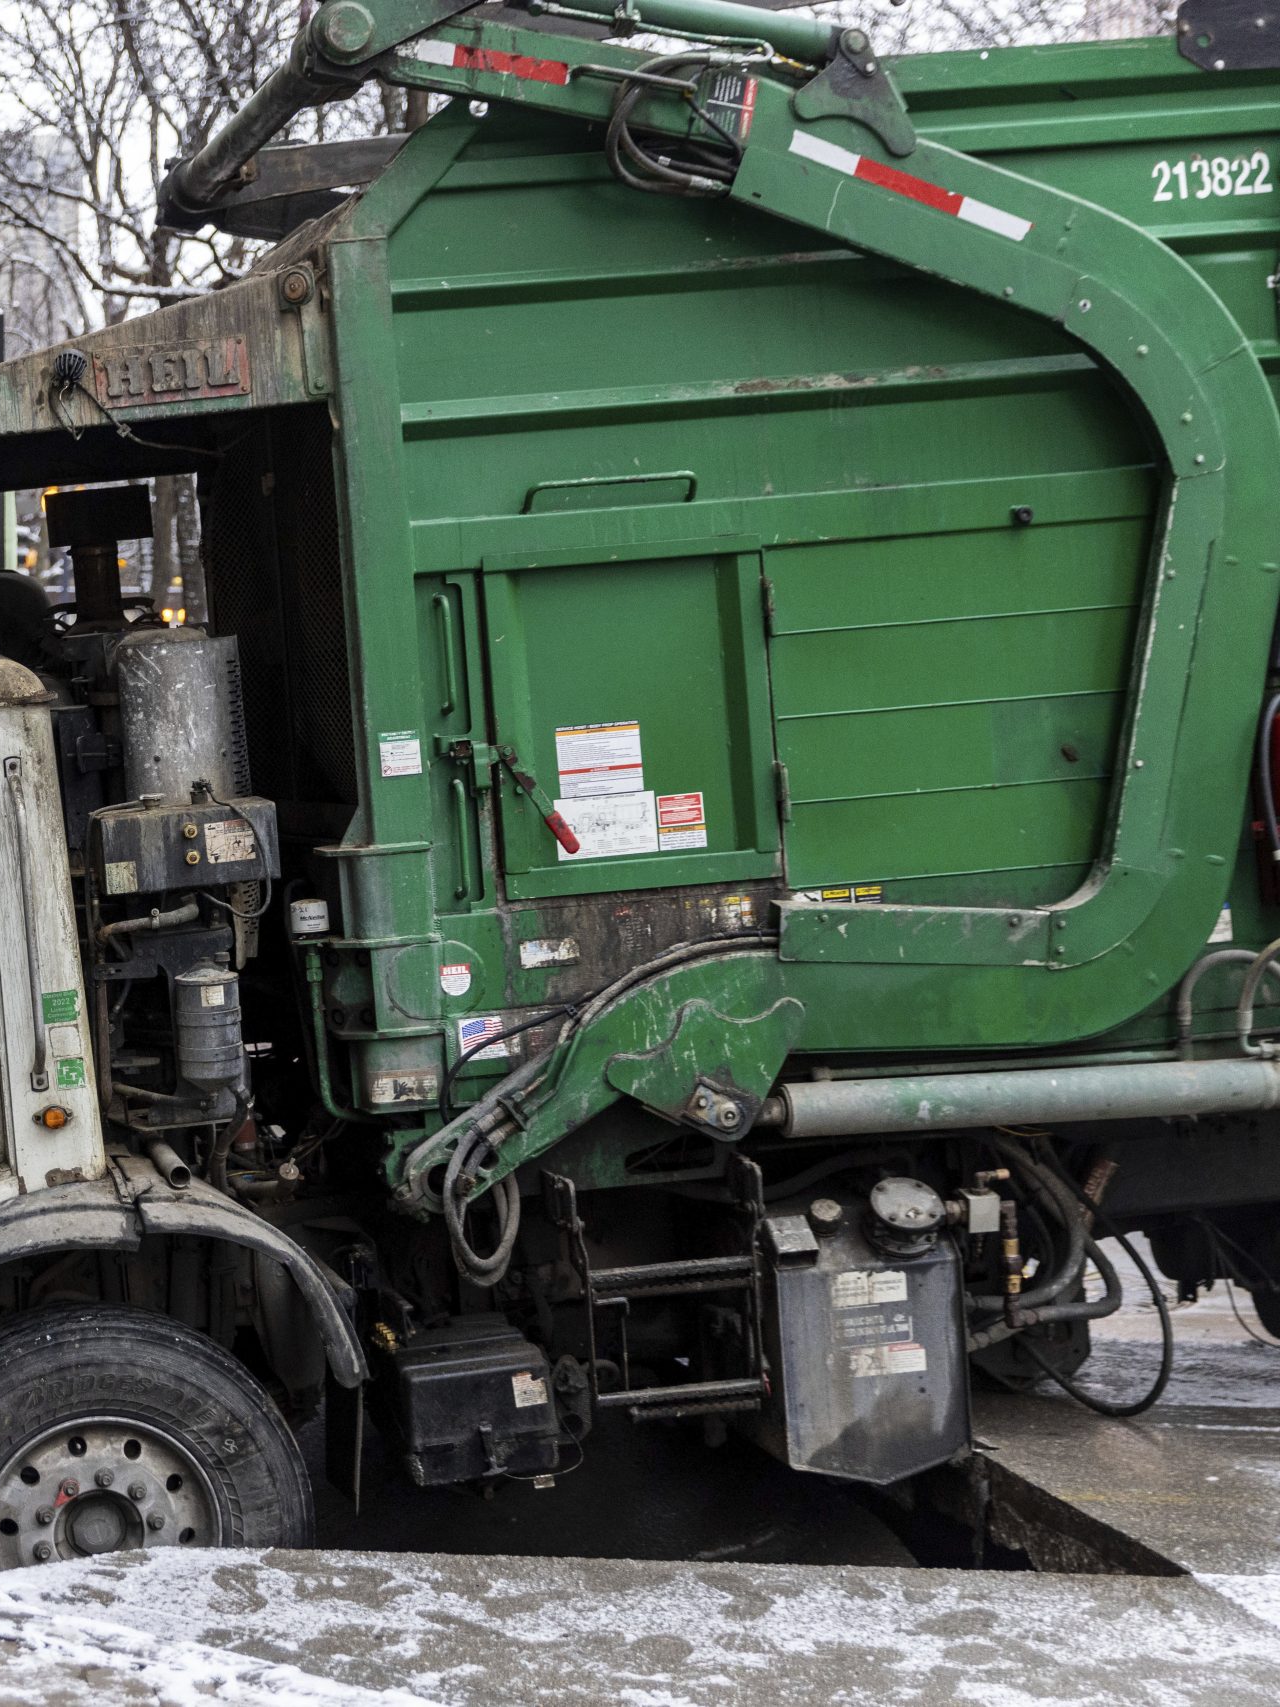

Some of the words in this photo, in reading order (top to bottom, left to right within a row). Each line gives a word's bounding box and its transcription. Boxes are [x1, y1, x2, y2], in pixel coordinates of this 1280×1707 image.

[1151, 151, 1274, 202] 213822
[105, 348, 241, 397] HEIL
[443, 965, 469, 975] HEIL
[52, 998, 70, 1006] 2022
[24, 1373, 217, 1427] BRIDGESTONE
